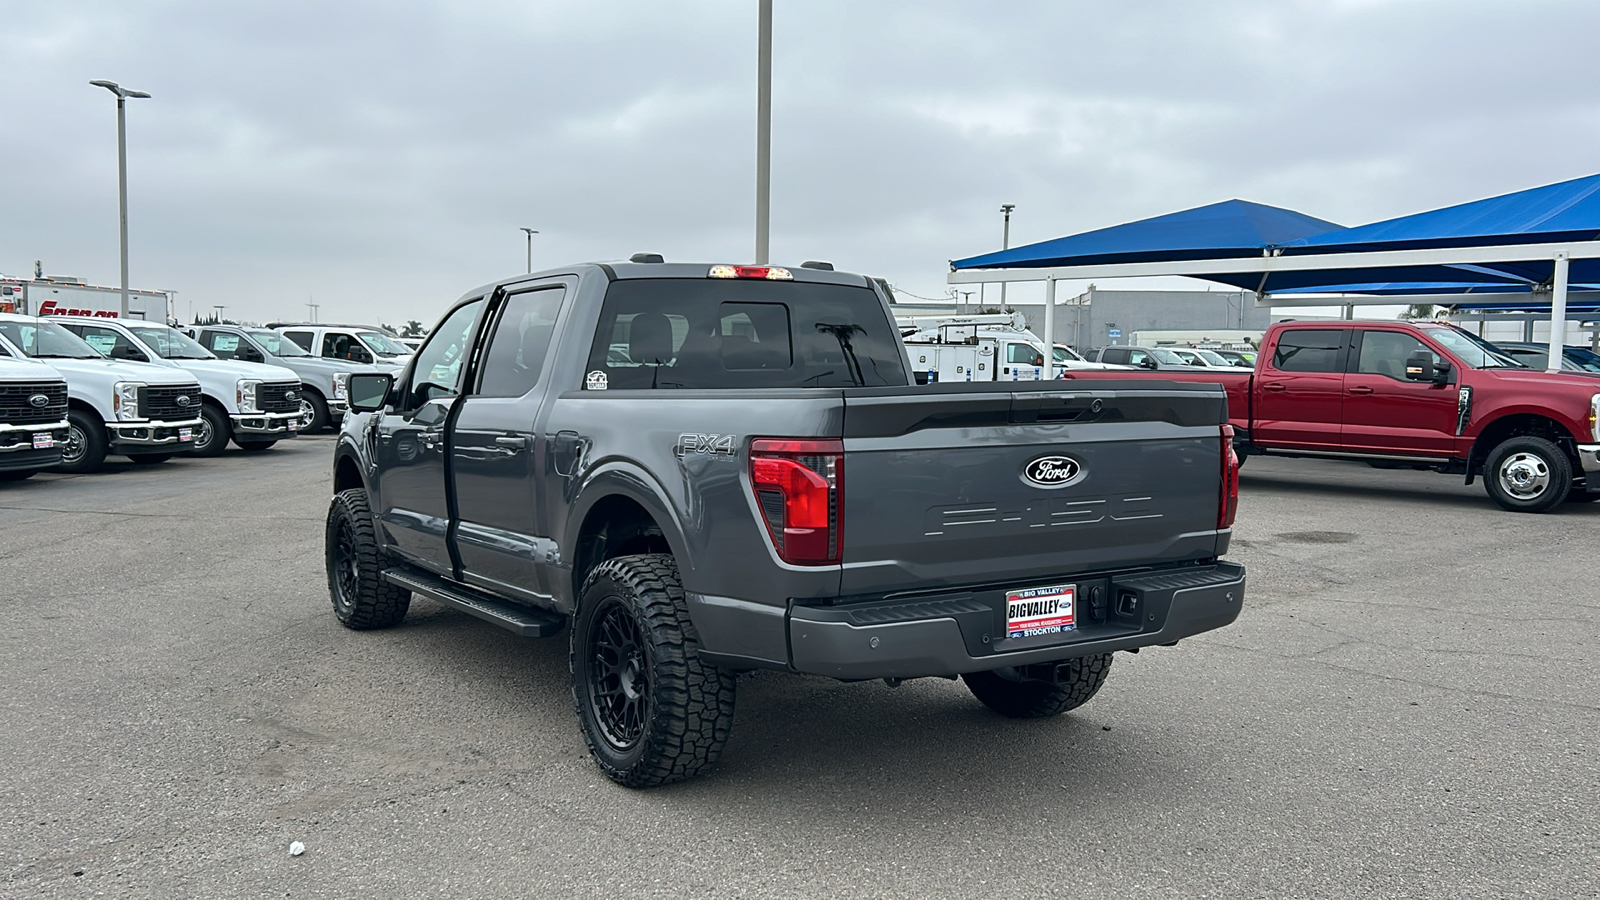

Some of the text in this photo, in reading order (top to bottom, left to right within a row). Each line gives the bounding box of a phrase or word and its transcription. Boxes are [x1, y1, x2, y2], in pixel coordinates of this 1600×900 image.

[678, 433, 736, 458] FX4
[1034, 459, 1073, 481] Ford
[1037, 588, 1060, 596] VALLEY
[1009, 599, 1059, 618] BIGVALLEY
[1024, 626, 1061, 637] STOCKTON
